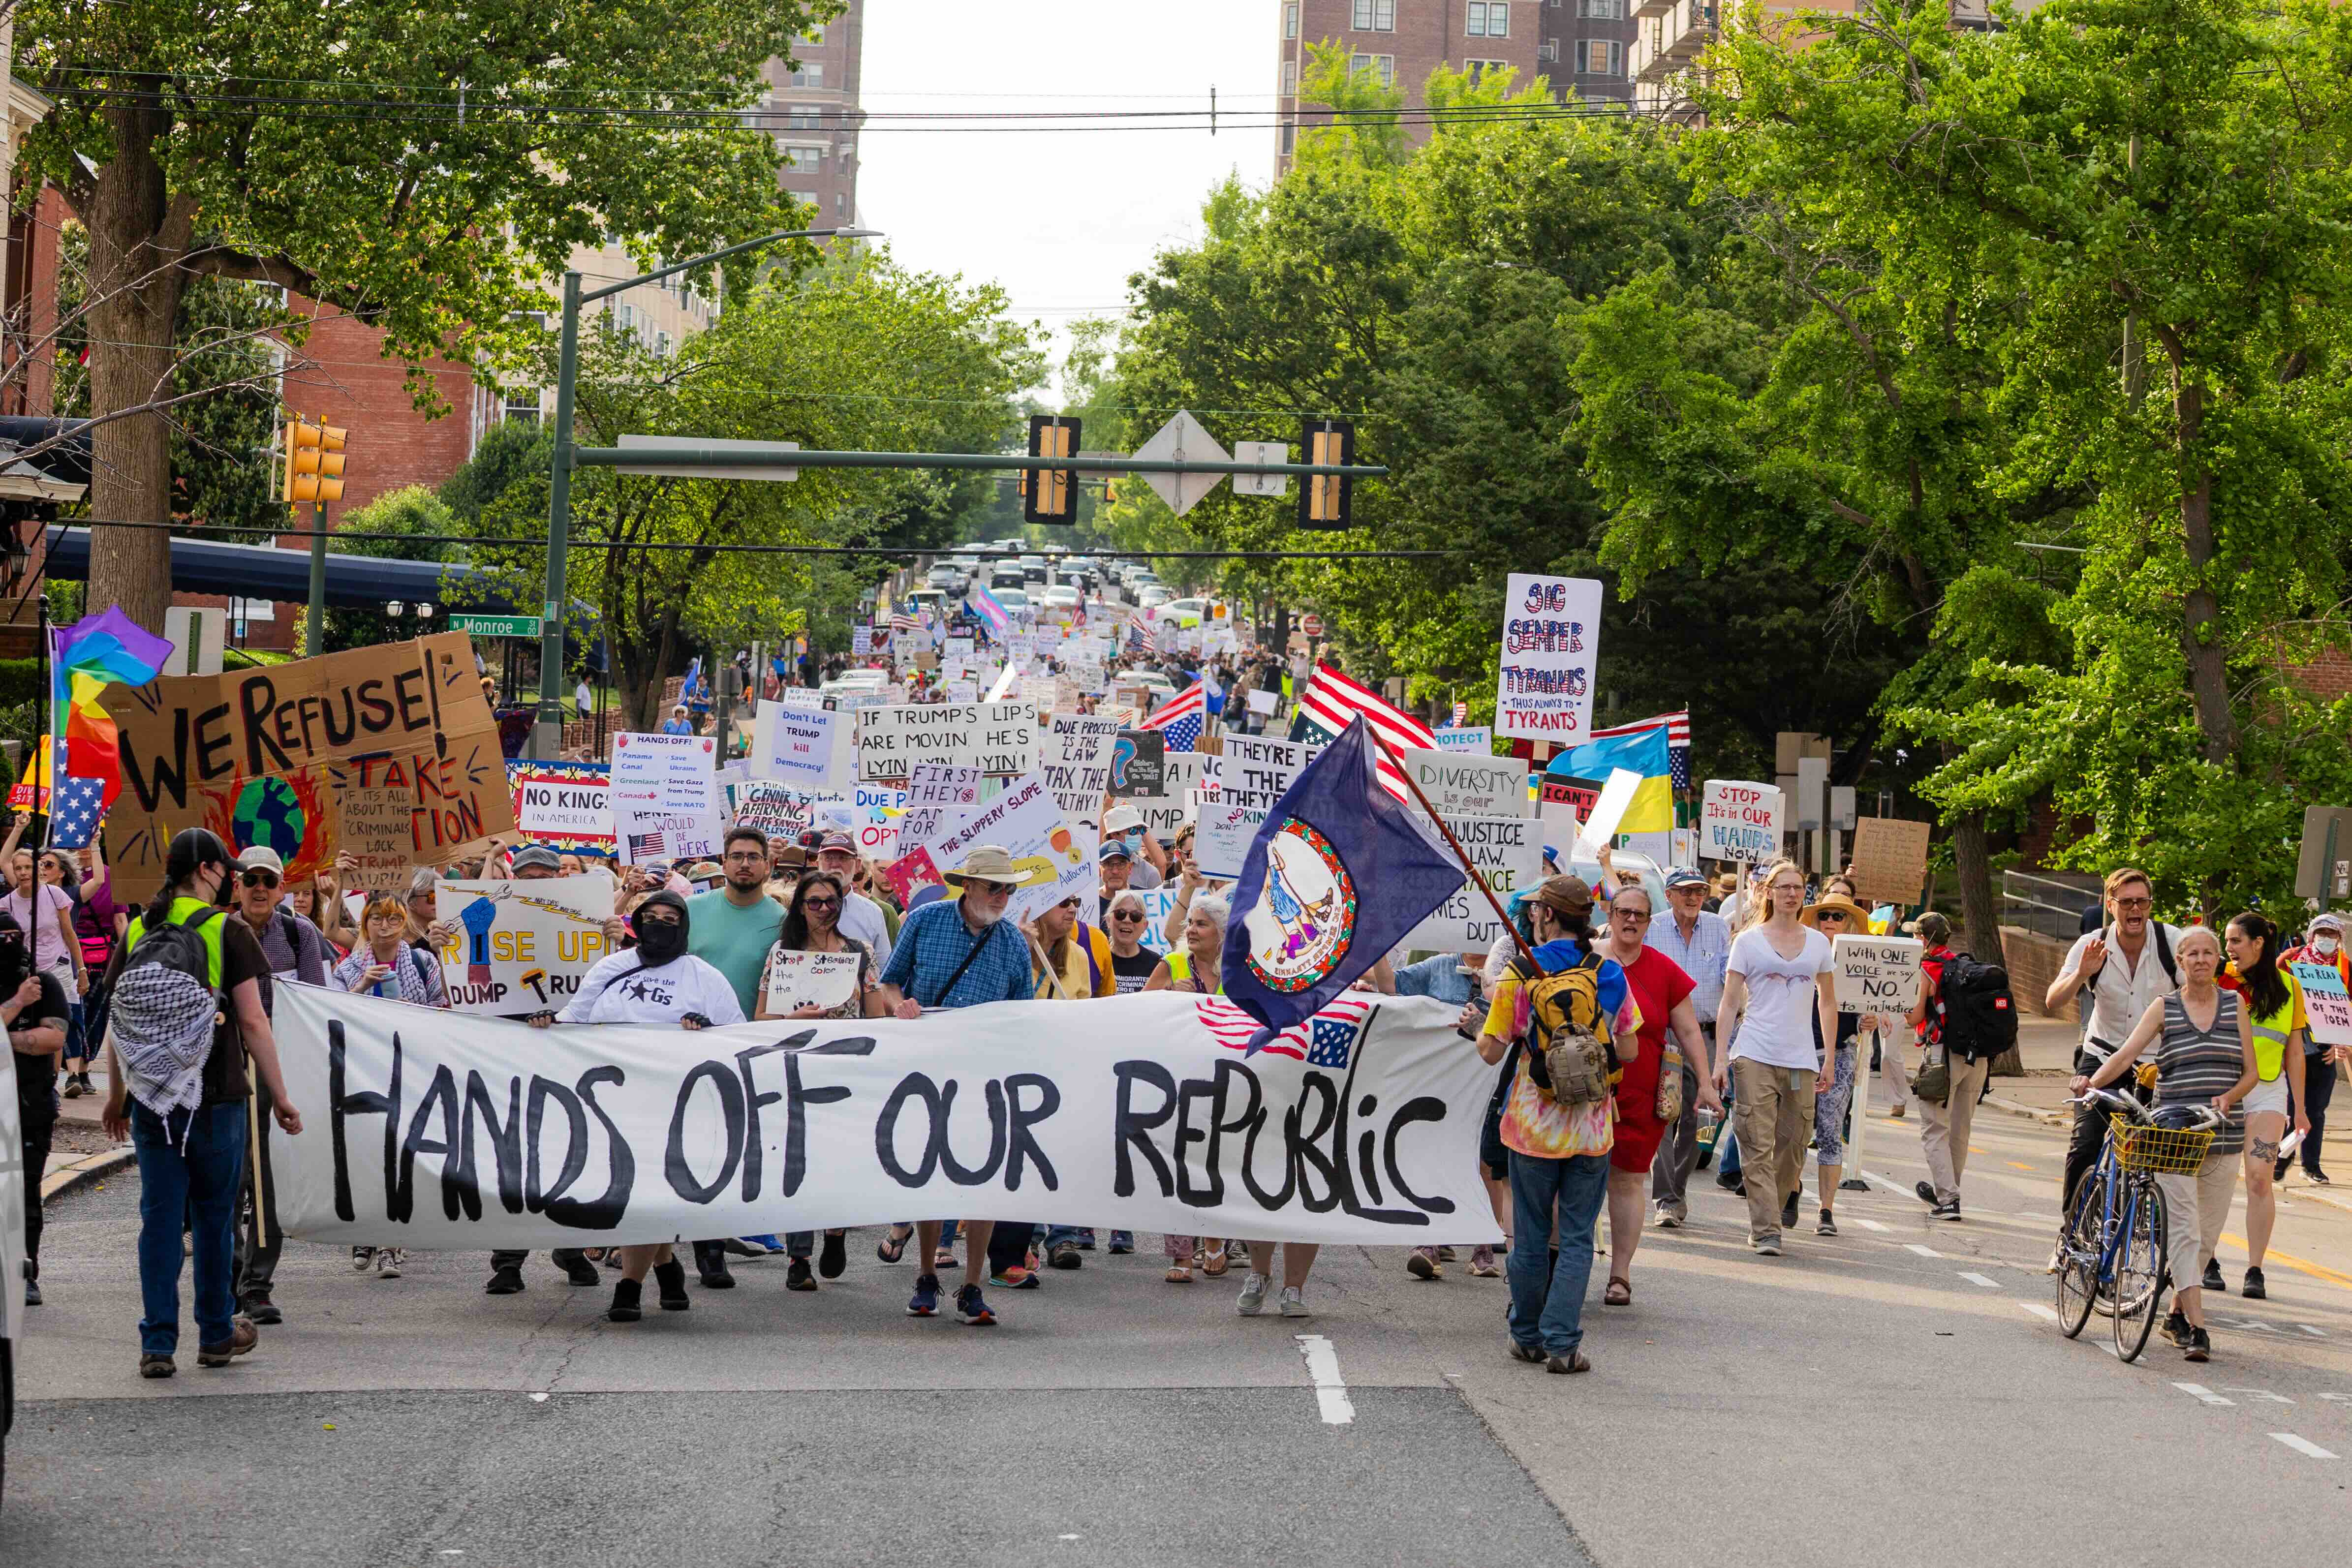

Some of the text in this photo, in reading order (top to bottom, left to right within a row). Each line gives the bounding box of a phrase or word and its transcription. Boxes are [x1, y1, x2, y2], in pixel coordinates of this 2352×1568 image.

[1524, 583, 1566, 614] SIC
[453, 620, 459, 629] N
[464, 618, 513, 634] Monroe
[1507, 619, 1583, 654] SEMPER
[1501, 665, 1586, 696] TYRANNIS
[1511, 698, 1574, 708] THUS ALWAYS TO
[783, 710, 827, 725] Don't Let
[864, 704, 1035, 726] IF TRUMP'S LIPS
[1505, 710, 1578, 731] TYRANTS
[118, 648, 448, 812] WE REFUSE!
[787, 727, 820, 738] TRUMP
[1053, 720, 1118, 735] DUE PROCESS
[637, 736, 669, 744] HANDS
[862, 735, 895, 750] ARE
[987, 728, 1029, 744] HE'S
[1062, 736, 1100, 748] IS THE
[1436, 733, 1483, 744] ROTECT
[794, 742, 809, 753] kill
[1062, 748, 1099, 761] LAW
[1226, 739, 1295, 767] THEY'RE
[775, 758, 824, 772] Democracy!
[348, 752, 461, 804] TAKE
[913, 766, 980, 783] FIRST
[1044, 766, 1108, 790] TAX THE
[1243, 769, 1288, 792] THE
[1420, 764, 1521, 796] DIVERSITY
[11, 794, 35, 803] -SIT
[16, 786, 48, 797] DIVR
[345, 790, 407, 802] IF ITS ALL
[526, 788, 551, 806] NO
[750, 788, 791, 804] GENDER
[857, 790, 889, 806] DUE
[909, 785, 963, 802] THEY
[1444, 791, 1494, 807] is our
[1545, 789, 1593, 805] I CAN'T
[1719, 787, 1761, 805] STOP
[346, 803, 410, 816] ABOUT THE
[740, 803, 805, 820] AFFIRMING
[1227, 808, 1267, 824] NO KIN
[1728, 807, 1737, 819] in
[1742, 807, 1771, 827] OUR
[532, 813, 597, 826] IN AMERICA
[653, 817, 695, 831] WOULD
[939, 782, 1043, 856] THE SLIPPERY SLOPE
[677, 831, 686, 842] BE
[366, 839, 397, 853] LOCK
[678, 840, 712, 857] HERE
[1725, 846, 1759, 862] NOW
[353, 855, 407, 870] TRUMP
[1058, 861, 1091, 888] Autocracy
[443, 930, 535, 965] RISE
[1848, 947, 1910, 962] With ONE
[775, 968, 794, 980] the
[1846, 964, 1882, 976] VOICE
[1901, 971, 1917, 983] say
[2316, 970, 2336, 980] READ
[453, 971, 585, 1006] DUMP TRU
[775, 984, 792, 995] the
[2303, 987, 2349, 1002] THE REST
[1840, 1001, 1856, 1012] to
[2313, 1002, 2348, 1015] OF THE
[2323, 1014, 2350, 1027] POEM
[327, 1019, 635, 1229] HANDS
[664, 1028, 877, 1204] OFF
[875, 1071, 1061, 1192] OUR
